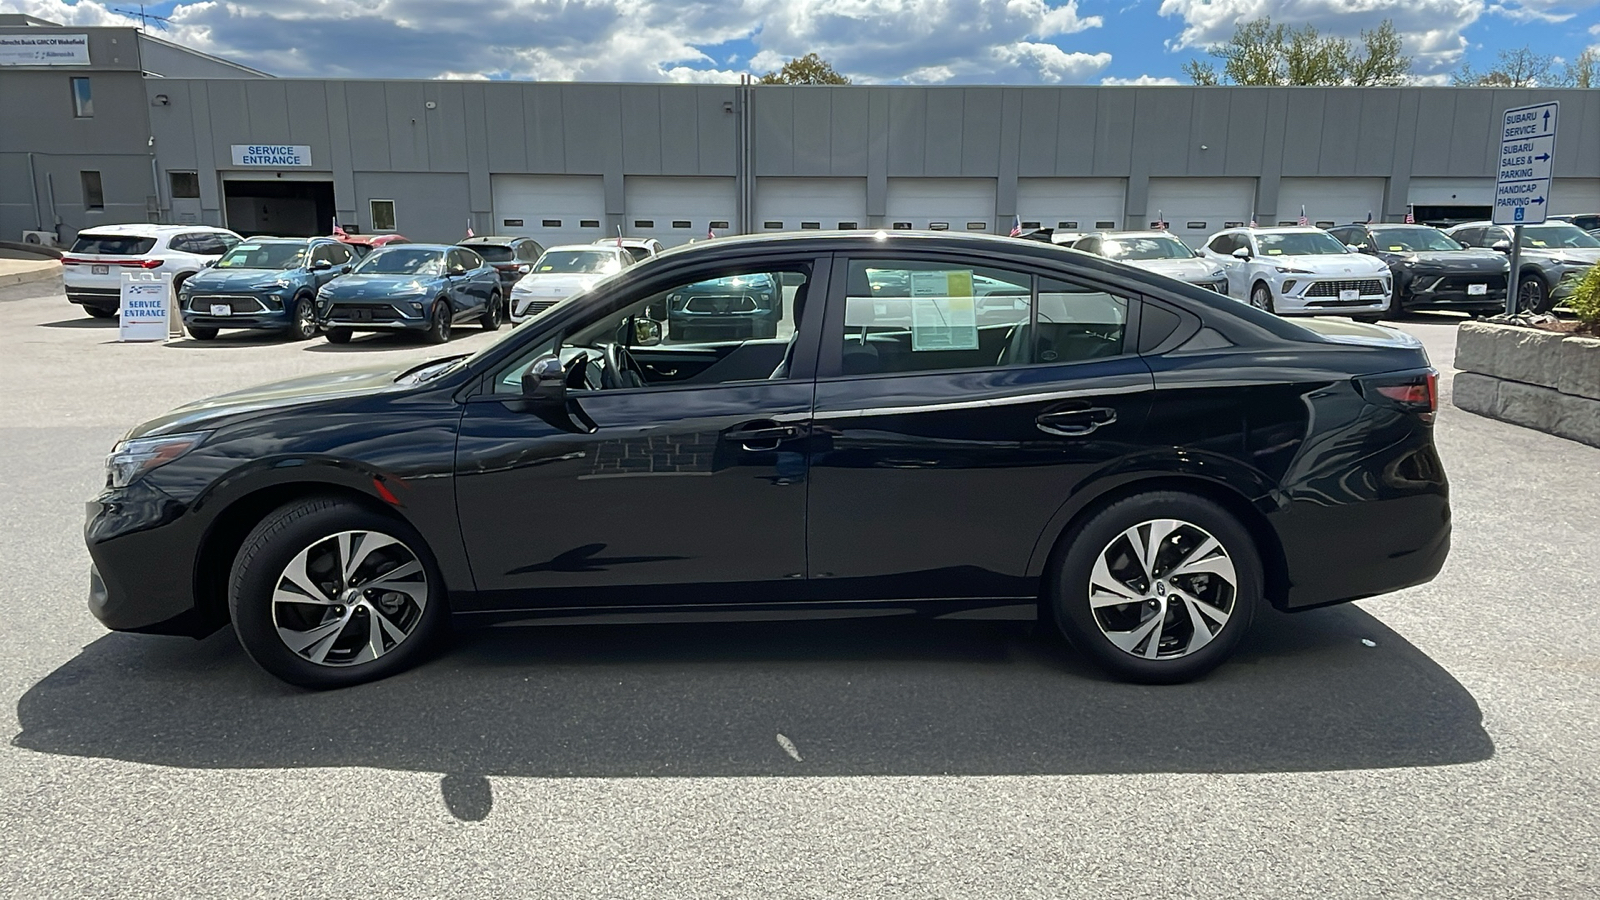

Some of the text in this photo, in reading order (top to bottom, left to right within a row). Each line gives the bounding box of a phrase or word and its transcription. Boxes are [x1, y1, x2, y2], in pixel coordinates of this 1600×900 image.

[1506, 112, 1538, 125] SUBARU
[1505, 124, 1537, 137] SERVICE
[248, 146, 294, 155] SERVICE
[1503, 143, 1534, 155] SUBARU
[242, 156, 301, 165] ENTRANCE
[1502, 156, 1533, 168] SALES &
[1500, 168, 1533, 180] PARKING
[1498, 184, 1537, 195] HANDICAP
[1497, 197, 1530, 207] PARKING
[129, 300, 161, 308] SERVICE
[124, 309, 166, 317] ENTRANCE
